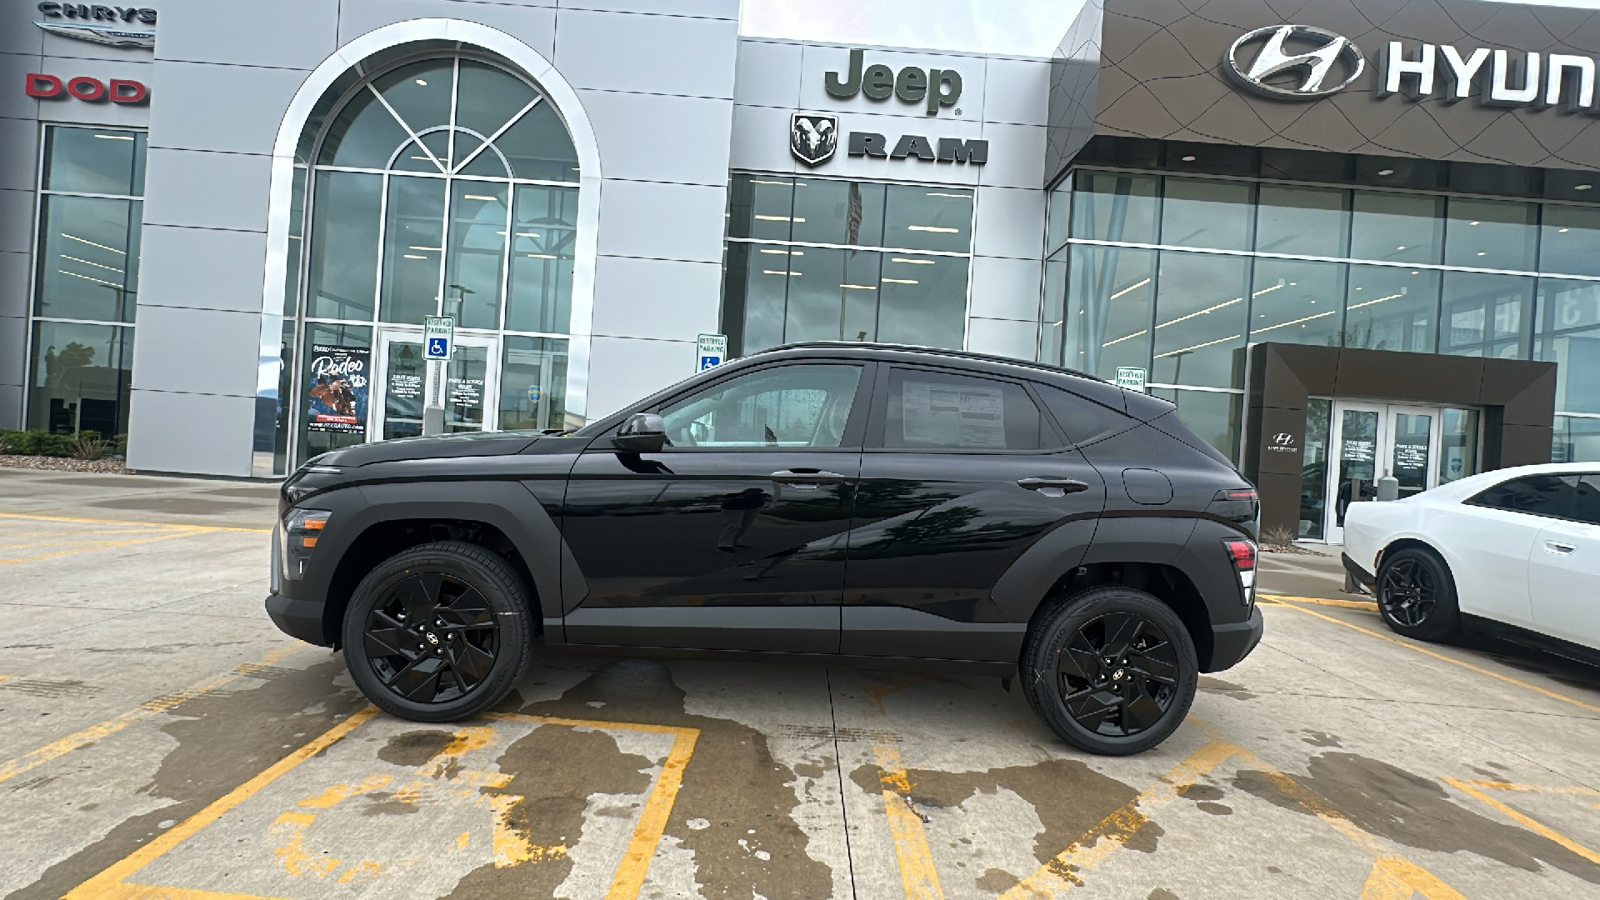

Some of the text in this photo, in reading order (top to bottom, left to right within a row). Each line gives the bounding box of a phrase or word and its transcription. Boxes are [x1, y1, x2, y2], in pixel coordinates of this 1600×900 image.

[825, 49, 963, 115] Jeep
[848, 131, 988, 165] RAM
[427, 319, 452, 327] RESERVED
[700, 337, 723, 345] RESERVED
[311, 356, 364, 379] Rodeo
[1119, 370, 1143, 379] RESERVED
[1118, 378, 1142, 386] PARKING
